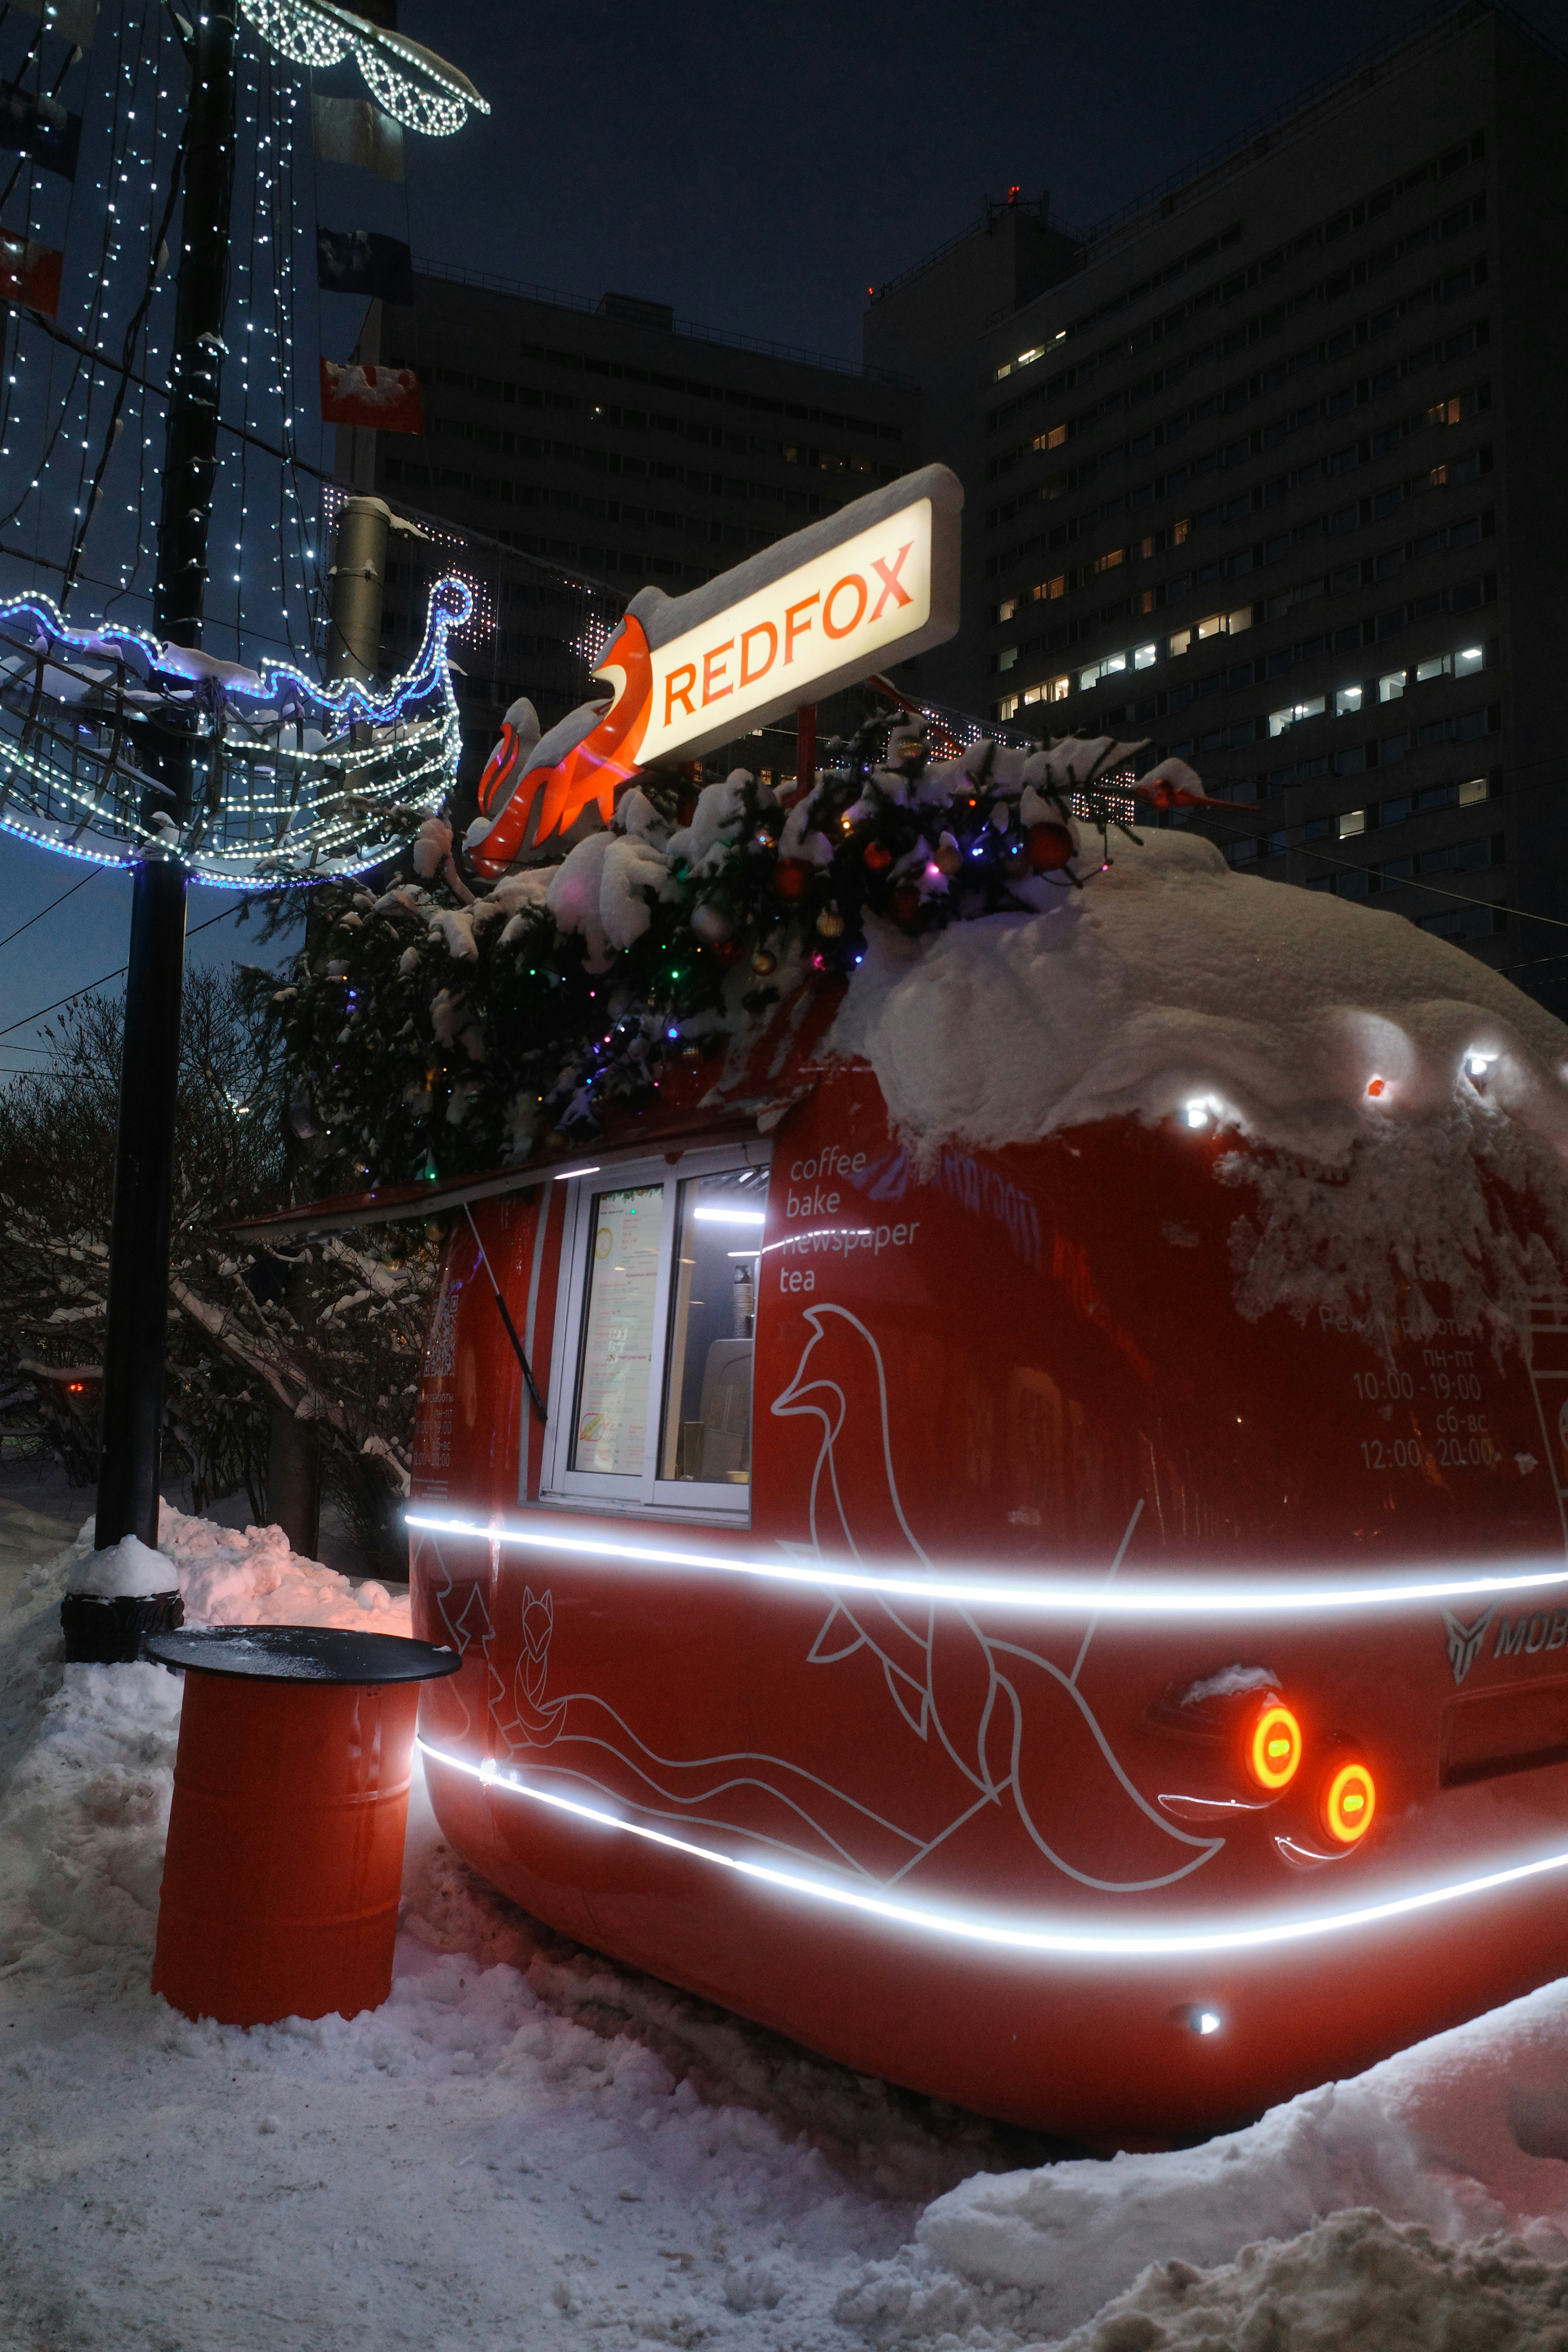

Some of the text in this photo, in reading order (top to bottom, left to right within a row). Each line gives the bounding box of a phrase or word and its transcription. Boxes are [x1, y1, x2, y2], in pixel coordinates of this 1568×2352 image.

[663, 541, 914, 728] REDFOX
[790, 1145, 866, 1181] coffee
[786, 1185, 841, 1218] bake
[782, 1222, 920, 1258] newspaper
[780, 1267, 815, 1293] tea
[1422, 1349, 1474, 1367] пн-пт
[1352, 1371, 1414, 1400] 10:00
[1429, 1372, 1481, 1400] 19:00
[1436, 1406, 1488, 1433] сб-вс
[1361, 1439, 1421, 1469] 12:00
[1437, 1438, 1493, 1466] 20:00
[1493, 1607, 1568, 1659] MOB
